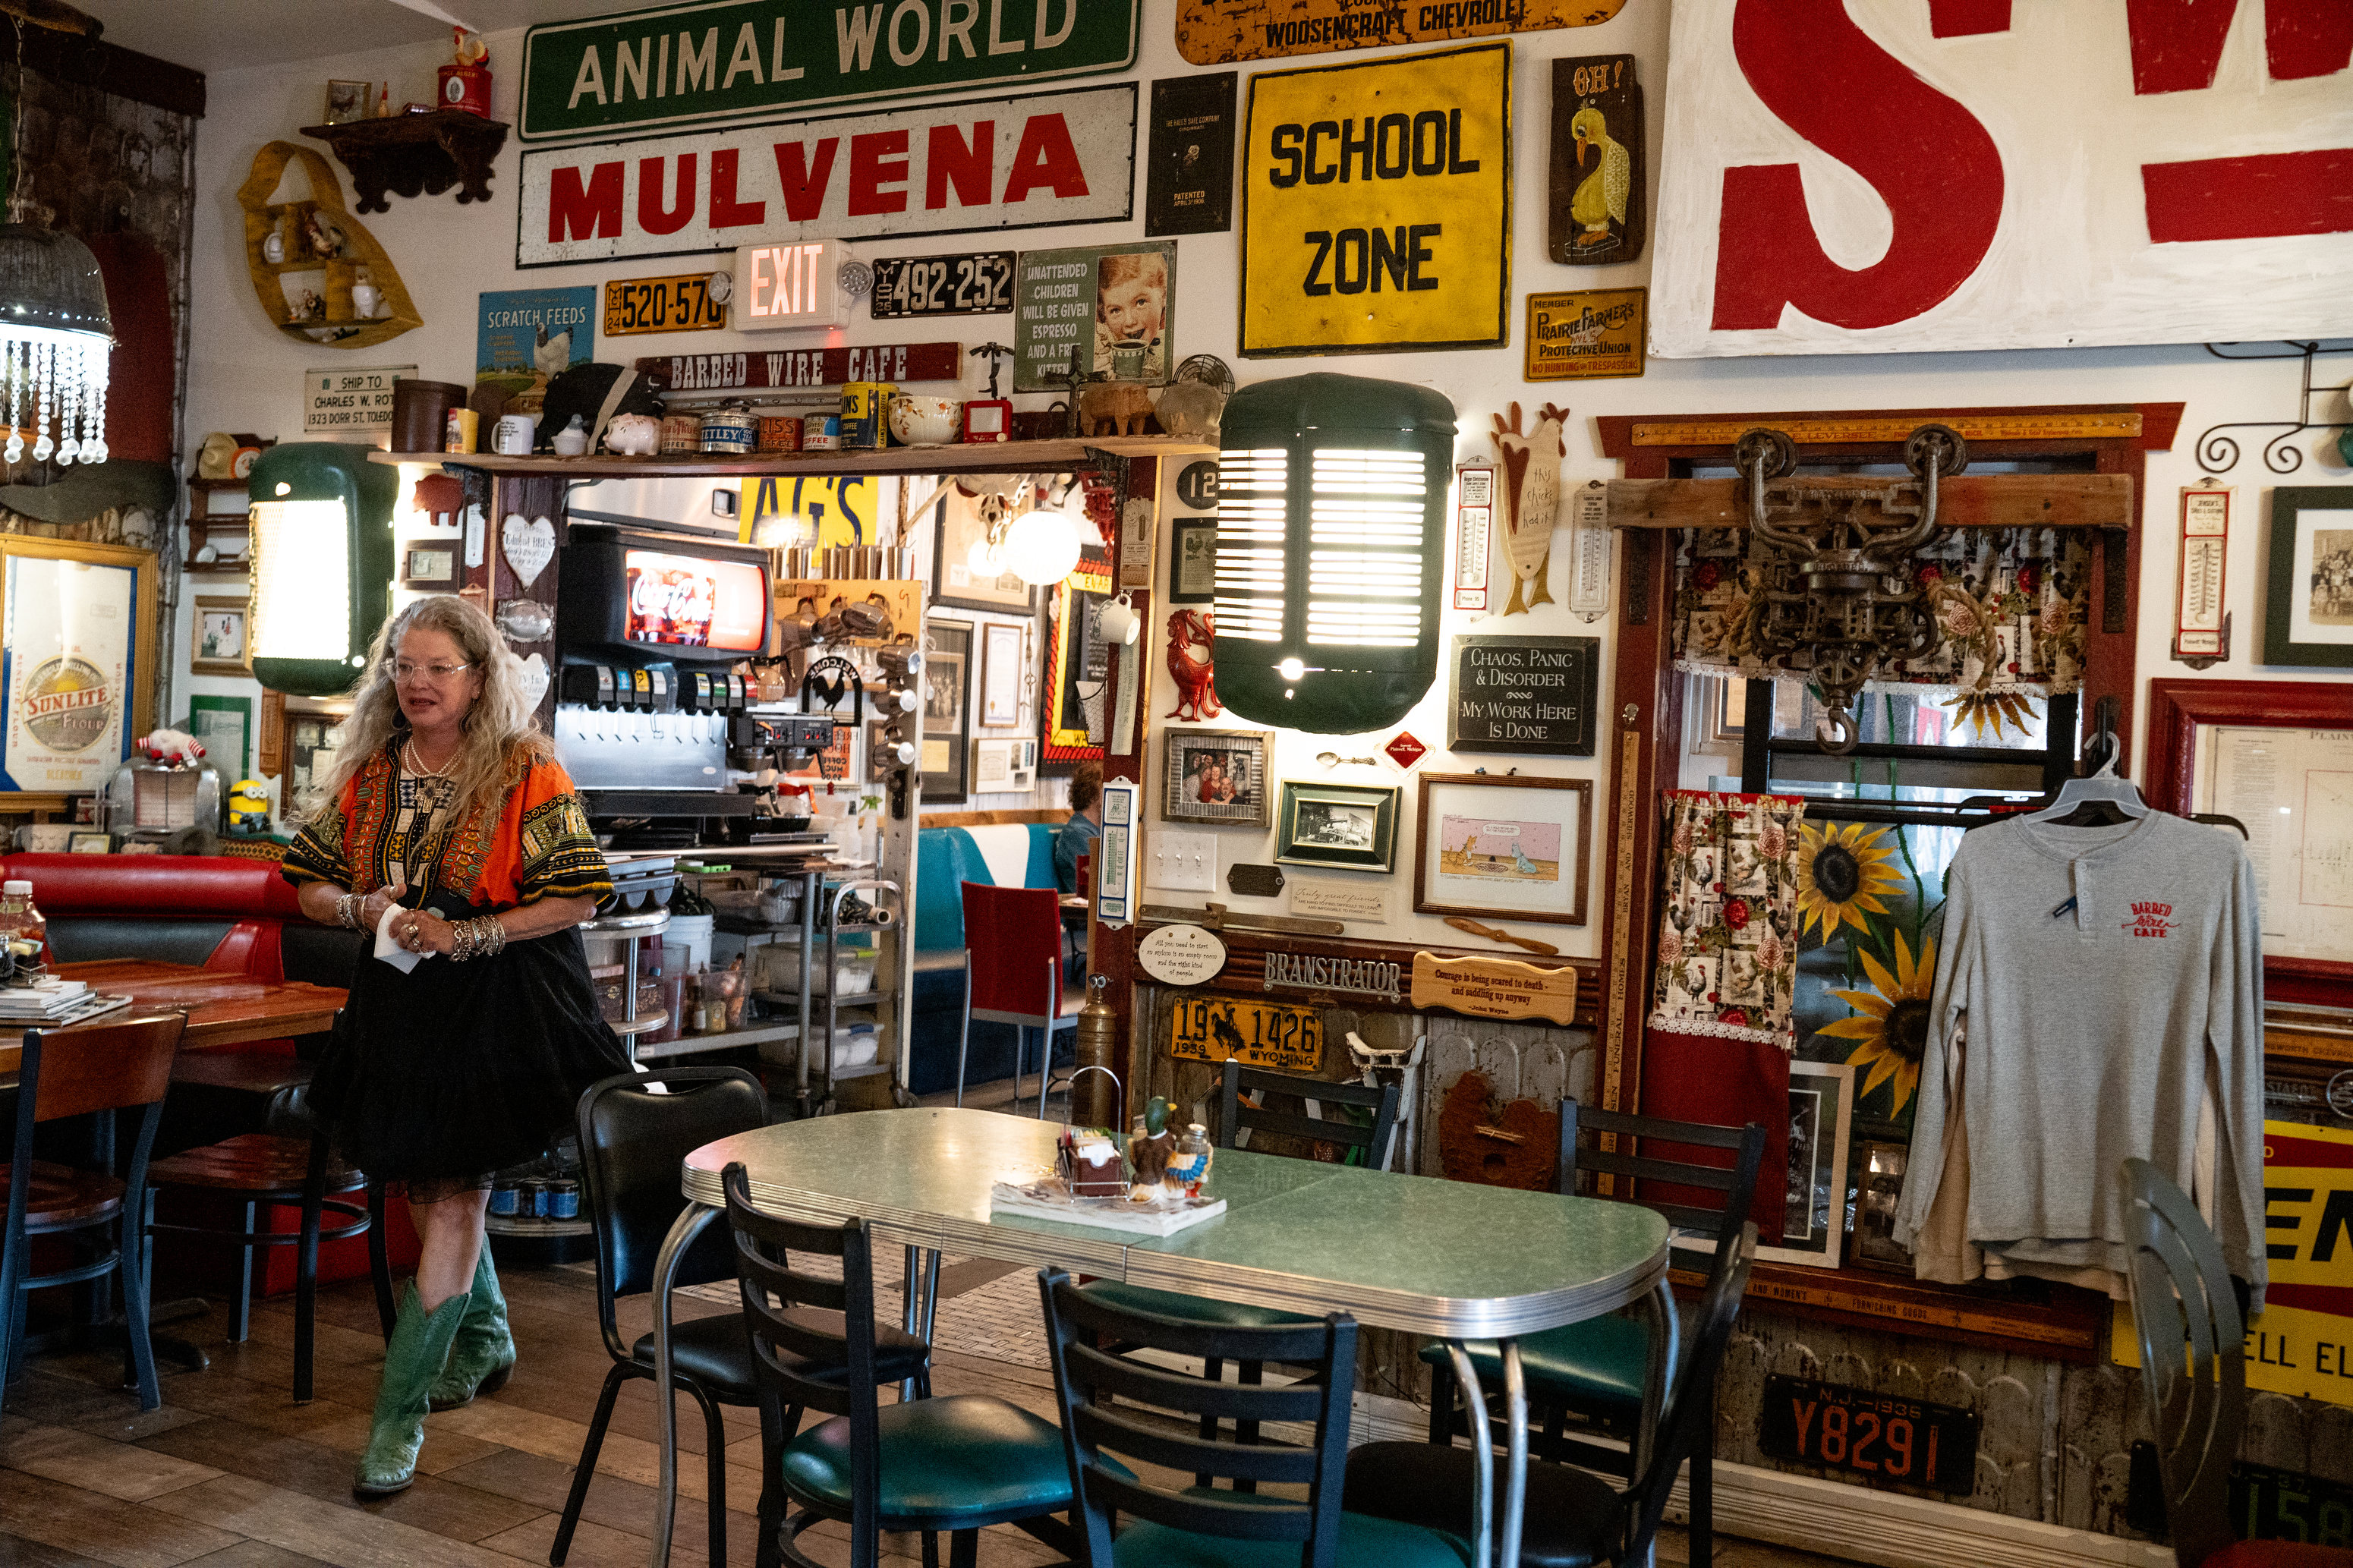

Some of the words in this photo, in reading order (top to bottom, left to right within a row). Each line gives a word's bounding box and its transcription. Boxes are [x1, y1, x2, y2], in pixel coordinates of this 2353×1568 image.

[1266, 8, 1409, 48] WOOSENCRAFT
[1419, 0, 1526, 31] CHEVROLET
[567, 17, 805, 109] ANIMAL
[836, 0, 1078, 74] WORLD
[1188, 117, 1199, 125] SAFE
[1199, 115, 1220, 124] COMPANY
[1269, 108, 1480, 188] SCHOOL
[548, 112, 1090, 244] MULVENA
[1174, 190, 1205, 200] PATENTED
[1302, 224, 1441, 296] ZONE
[750, 244, 824, 317] EXIT
[1027, 263, 1088, 281] UNATTENDED
[893, 258, 1011, 311] 492-252
[1035, 283, 1079, 299] CHILDREN
[1023, 305, 1044, 320] WILL
[1047, 304, 1058, 318] BE
[1060, 302, 1088, 317] GIVEN
[1534, 300, 1573, 309] MEMBER
[487, 309, 540, 329] SCRATCH
[547, 307, 586, 326] FEEDS
[1032, 323, 1076, 338] ESPRESSO
[1027, 345, 1047, 358] AND
[1049, 344, 1055, 357] A
[1539, 344, 1598, 357] PROTECTIVE
[1599, 342, 1631, 354] UNION
[671, 354, 747, 389] BARBED
[767, 352, 824, 387] WIRE
[849, 347, 906, 382] CAFE
[1532, 364, 1543, 373] NO
[1545, 361, 1580, 373] HUNTING
[1588, 360, 1638, 370] TRESPASSING
[342, 376, 363, 389] SHIP
[367, 376, 382, 388] TO
[315, 395, 354, 408] CHARLES
[360, 395, 370, 407] W.
[308, 414, 326, 424] 1323
[329, 413, 350, 423] DORR
[353, 412, 364, 423] ST.
[1534, 468, 1551, 483] this
[1523, 511, 1539, 528] had
[1542, 512, 1548, 524] it
[632, 573, 713, 622] Coca-Cola
[1529, 649, 1573, 667] PANIC
[1476, 669, 1485, 685] &
[1490, 669, 1565, 687] DISORDER
[27, 686, 107, 716] SUNLITE
[1463, 701, 1484, 717] MY
[1488, 702, 1532, 719] WORK
[1536, 703, 1577, 720] HERE
[1489, 722, 1501, 738] IS
[1506, 722, 1548, 739] DONE
[2130, 902, 2172, 917] BARBED
[2134, 927, 2167, 938] CAFE
[1265, 952, 1401, 993] BRANSTRATOR
[1435, 968, 1463, 984] Courage
[1463, 971, 1470, 982] is
[1471, 973, 1490, 987] being
[1491, 976, 1513, 987] scared
[1515, 978, 1522, 988] to
[1523, 979, 1544, 990] death
[1617, 957, 1626, 1000] HOMES
[1451, 986, 1464, 996] and
[1466, 987, 1494, 1002] saddling
[1495, 992, 1504, 1003] up
[1505, 993, 1531, 1006] anyway
[1488, 1006, 1509, 1015] Wayne
[1177, 1003, 1208, 1042] 19
[1251, 1009, 1317, 1053] 1426
[1613, 1012, 1622, 1073] FUNERAL
[1173, 1041, 1206, 1054] 1939
[1249, 1050, 1314, 1066] WYOMING
[1773, 1285, 1807, 1301] WOMEN'S
[1852, 1299, 1898, 1315] FURNISHING
[1903, 1305, 1928, 1320] GOODS
[1792, 1398, 1940, 1483] Y8291
